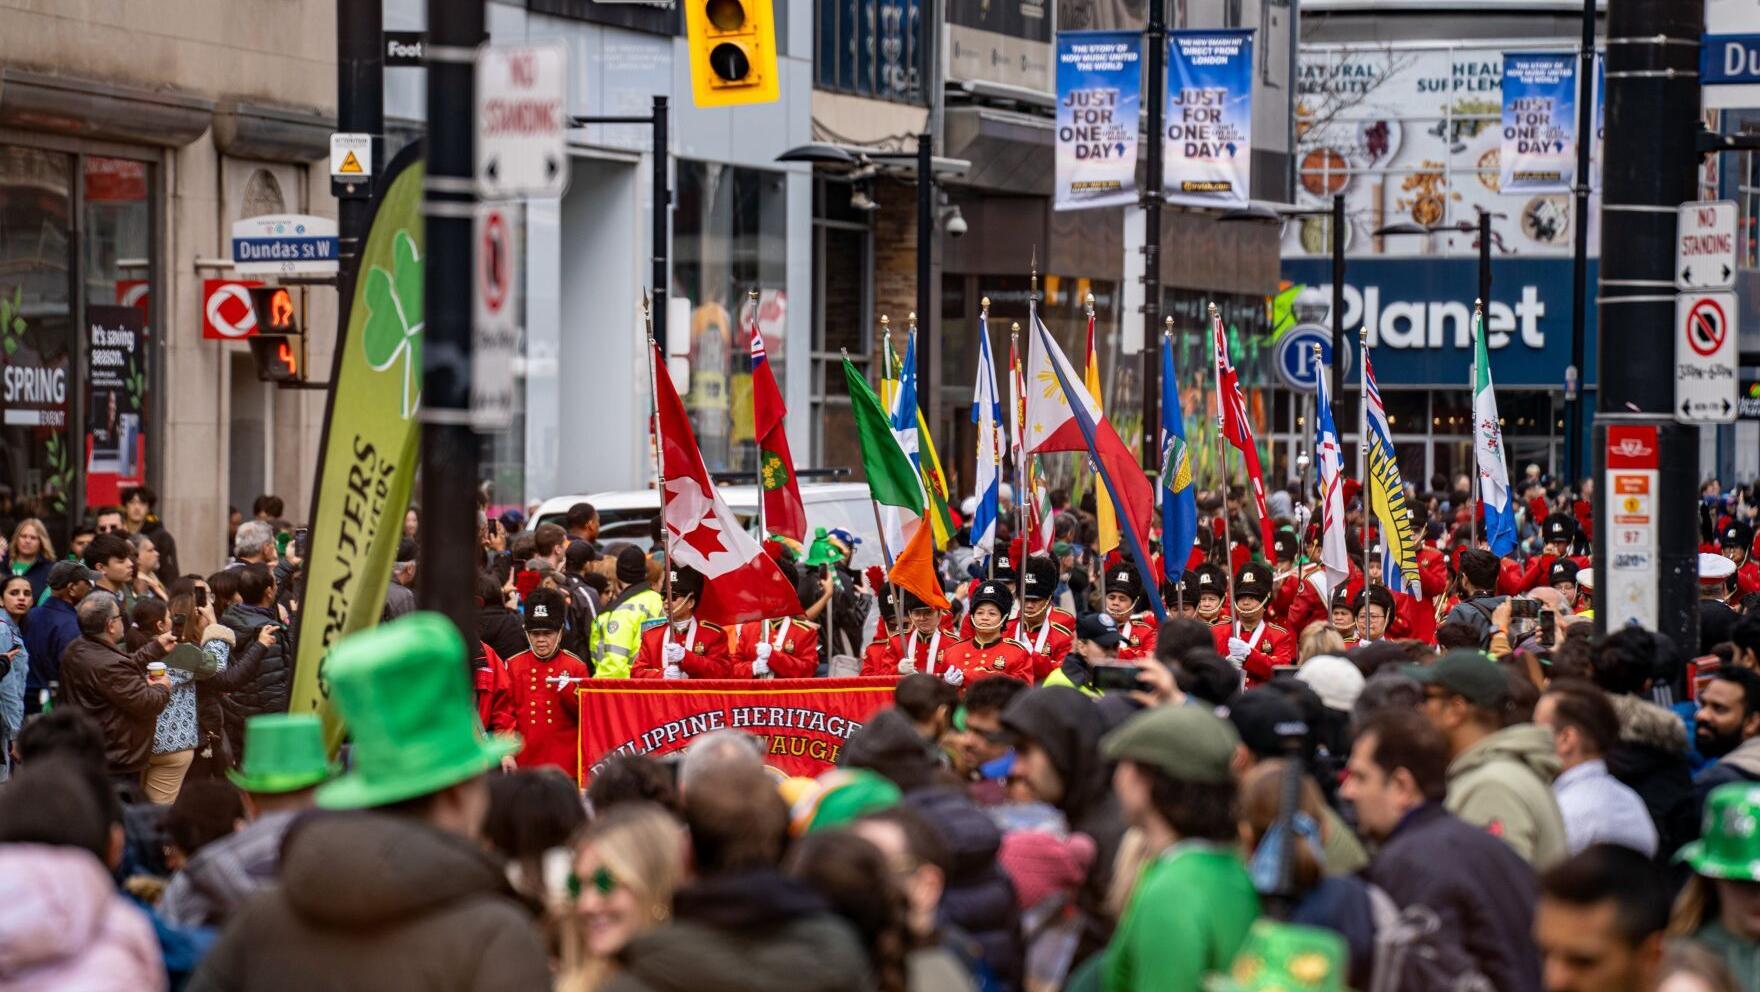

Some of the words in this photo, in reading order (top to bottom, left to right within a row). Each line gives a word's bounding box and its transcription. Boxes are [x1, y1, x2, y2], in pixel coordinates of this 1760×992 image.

[388, 41, 422, 57] Foot
[1072, 44, 1088, 53] THE
[1089, 44, 1115, 53] STORY
[1116, 43, 1128, 52] OF
[1182, 47, 1212, 56] DIRECT
[1214, 46, 1239, 56] FROM
[1061, 54, 1081, 63] HOW
[1083, 53, 1107, 62] MUSIC
[1109, 52, 1138, 61] UNITED
[1191, 56, 1228, 65] LONDON
[1076, 62, 1092, 71] THE
[1094, 62, 1124, 71] WORLD
[1064, 90, 1118, 107] JUST
[1174, 89, 1227, 106] JUST
[1508, 98, 1552, 113] JUST
[1073, 109, 1113, 124] FOR
[1183, 107, 1221, 123] FOR
[1515, 113, 1550, 126] FOR
[1060, 126, 1102, 142] ONE
[1168, 125, 1211, 140] ONE
[1504, 127, 1538, 140] ONE
[1075, 143, 1113, 159] DAY
[1184, 142, 1224, 158] DAY
[1517, 141, 1551, 154] DAY
[1698, 207, 1717, 228] NO
[240, 241, 299, 259] Dundas
[302, 243, 315, 258] St
[316, 240, 330, 258] W
[1682, 233, 1732, 255] STANDING
[92, 324, 106, 346] It's
[107, 325, 135, 353] saving
[92, 350, 124, 366] season.
[4, 365, 65, 404] SPRING
[589, 711, 725, 776] PILIPPINE
[731, 706, 863, 740] HERITAGE
